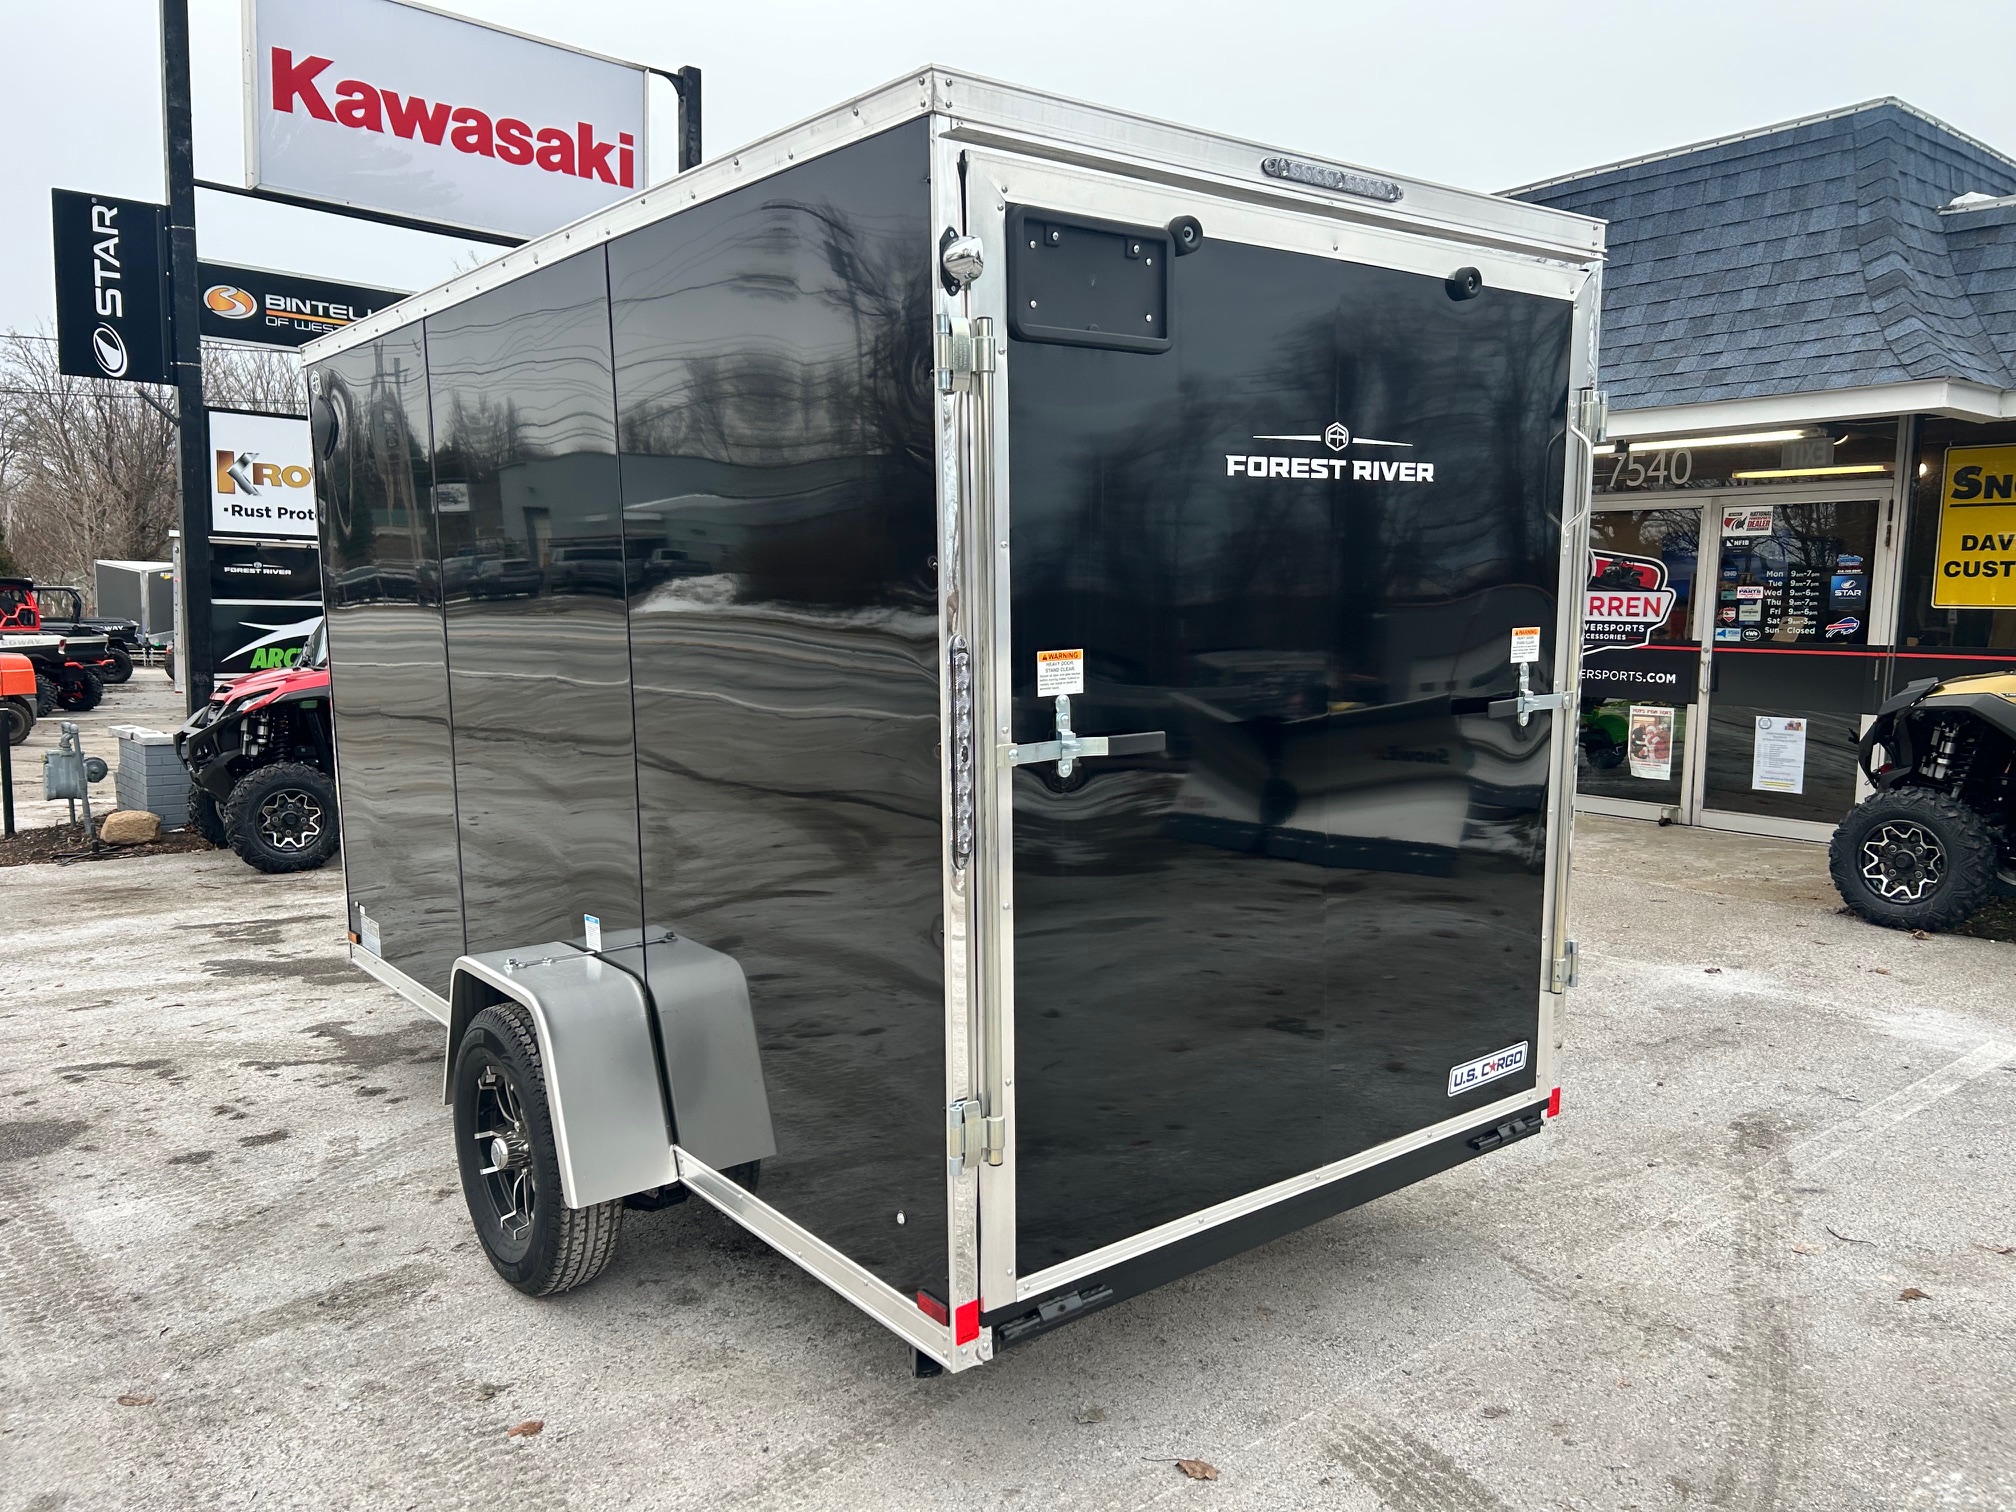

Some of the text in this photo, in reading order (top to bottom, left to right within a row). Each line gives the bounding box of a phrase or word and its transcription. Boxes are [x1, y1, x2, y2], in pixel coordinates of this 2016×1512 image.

[271, 46, 634, 189] Kawasaki
[91, 204, 122, 318] STAR
[265, 316, 342, 334] OF WES
[216, 449, 314, 497] KRO
[1225, 454, 1435, 483] FOREST RIVER
[1608, 447, 1693, 488] 7540
[1950, 465, 2016, 500] SN
[231, 504, 317, 521] Rust Prot
[1746, 520, 1771, 528] DEALER
[223, 566, 292, 576] FOREST RIVER
[1766, 598, 1782, 606] Thu
[1834, 589, 1862, 597] STAR
[1586, 596, 1662, 618] RREN
[101, 625, 124, 633] WAY
[1764, 626, 1816, 634] Sun Closed
[250, 647, 303, 669] ARC
[1048, 651, 1079, 660] WARNING
[1454, 1067, 1478, 1087] U.S.
